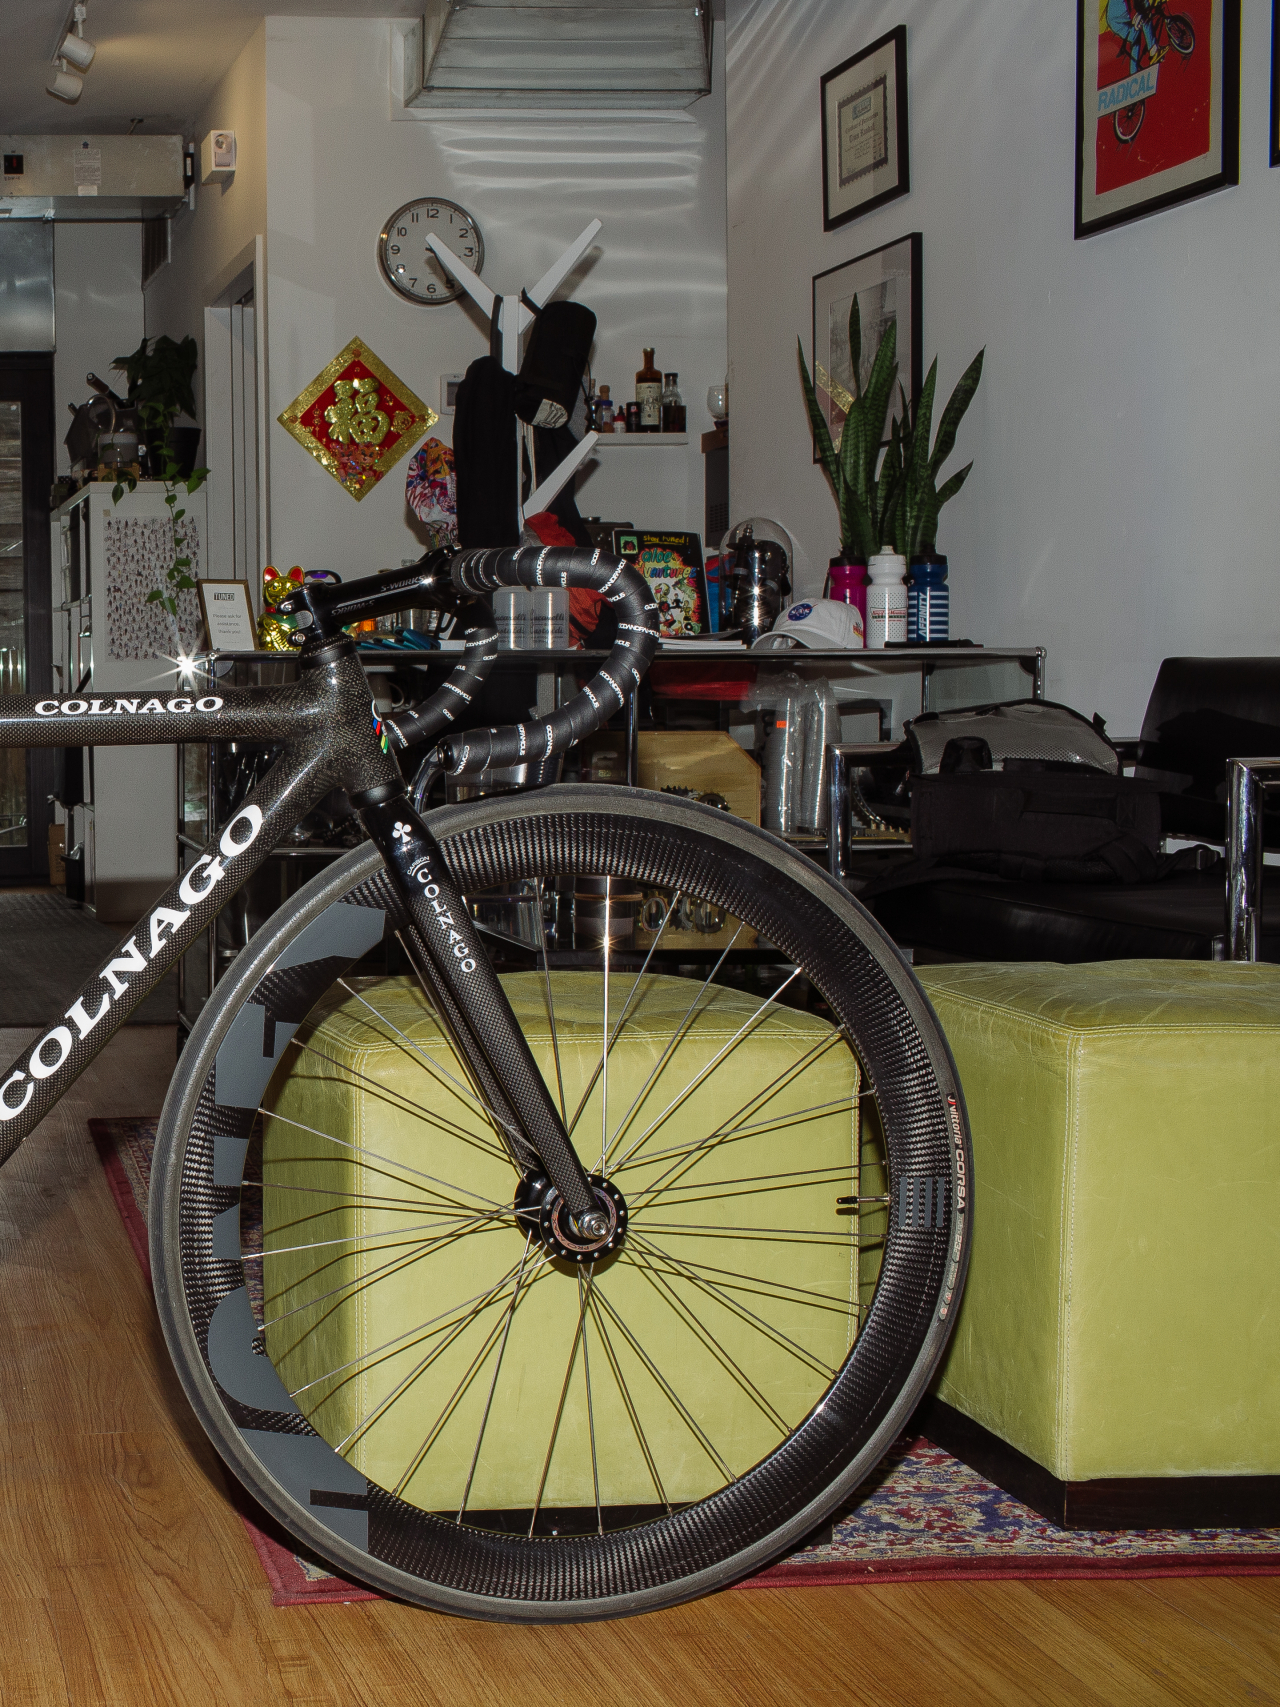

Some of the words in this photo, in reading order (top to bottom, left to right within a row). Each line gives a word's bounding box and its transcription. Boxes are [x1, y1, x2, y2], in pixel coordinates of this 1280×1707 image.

[1098, 72, 1154, 111] RADICAL
[411, 213, 419, 223] 11
[426, 208, 439, 219] 12
[449, 213, 453, 224] 1
[397, 227, 407, 237] 10
[459, 228, 469, 238] 2
[390, 244, 401, 255] 9
[463, 247, 474, 257] 3
[395, 264, 406, 274] 8
[409, 278, 418, 288] 7
[426, 284, 437, 293] 6
[324, 376, 391, 445] 福
[643, 534, 660, 544] stay
[641, 547, 672, 563] aloe
[637, 561, 697, 578] dventures
[380, 575, 426, 592] S-WORKS
[918, 591, 928, 637] AFFINITY
[34, 695, 224, 716] COLNAGO
[407, 855, 430, 875] CARBON
[416, 867, 477, 973] COLNAGO
[949, 1104, 963, 1145] vittoria
[955, 1149, 966, 1209] CORSA
